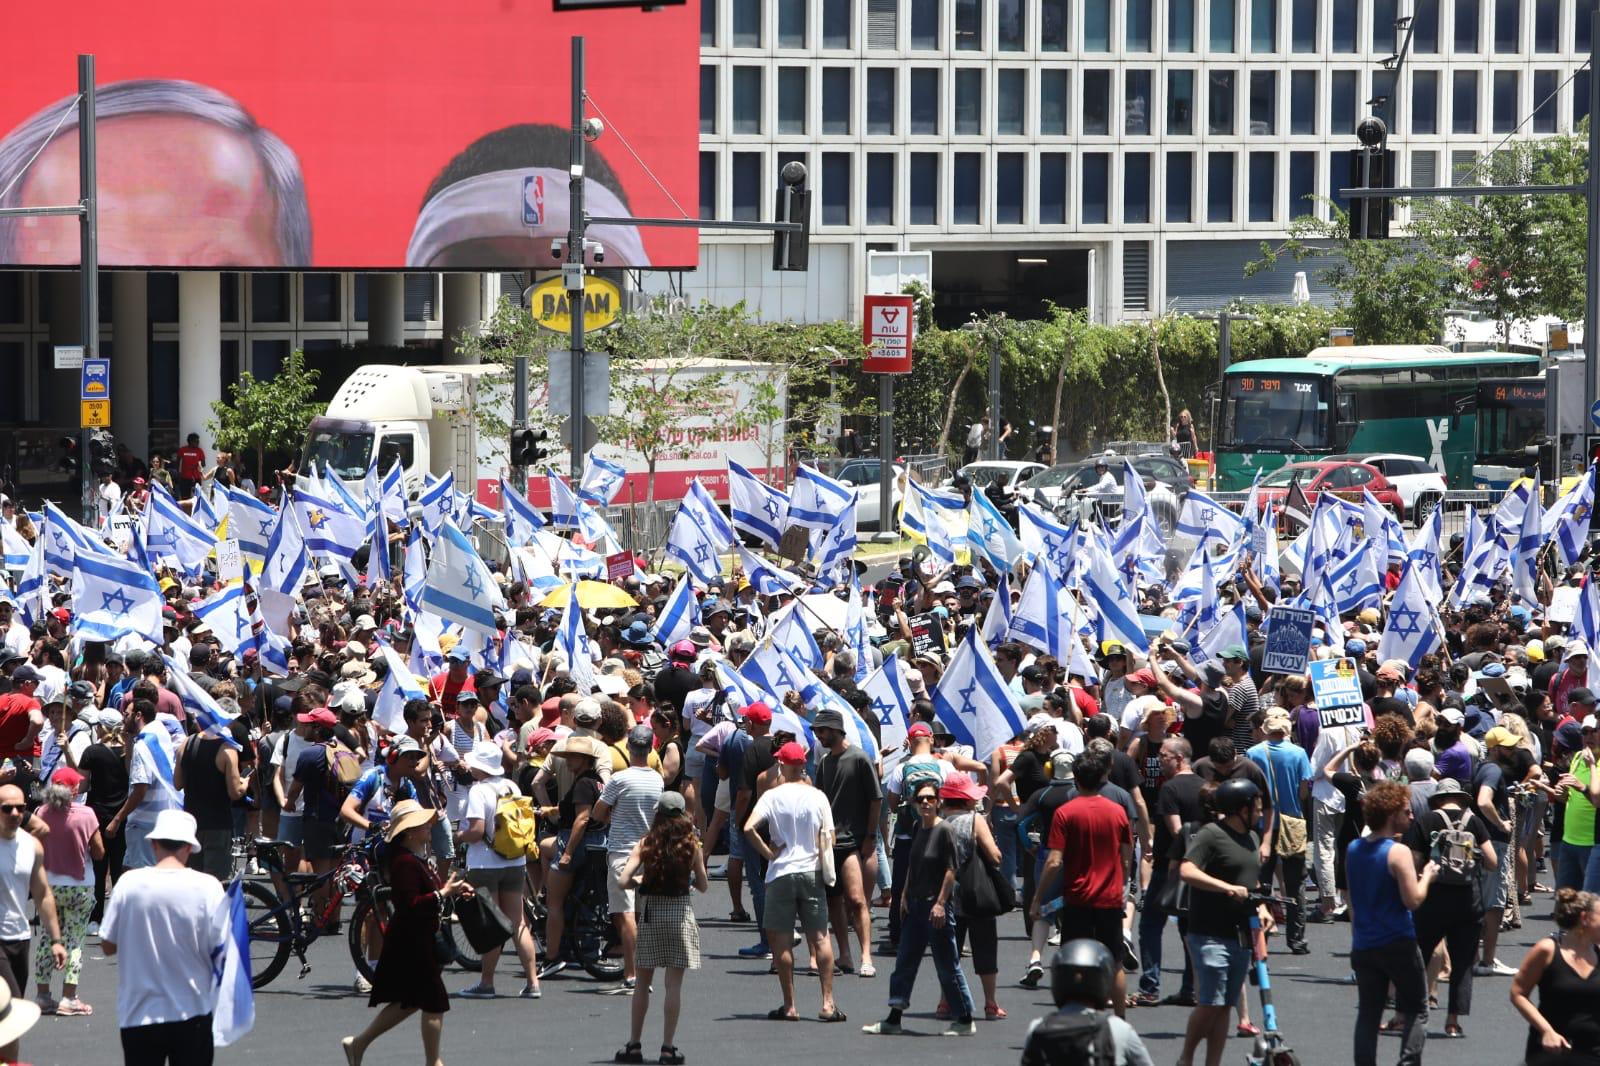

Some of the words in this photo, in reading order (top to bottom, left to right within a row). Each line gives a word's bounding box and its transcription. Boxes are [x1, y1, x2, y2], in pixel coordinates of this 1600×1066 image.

[542, 293, 610, 315] BAAM
[881, 325, 899, 333] niu
[1241, 377, 1255, 391] 910
[1260, 379, 1281, 391] חיפה
[1272, 609, 1313, 623] בחירות
[1267, 653, 1304, 670] עכשיו!
[1321, 706, 1362, 726] עכשיו!
